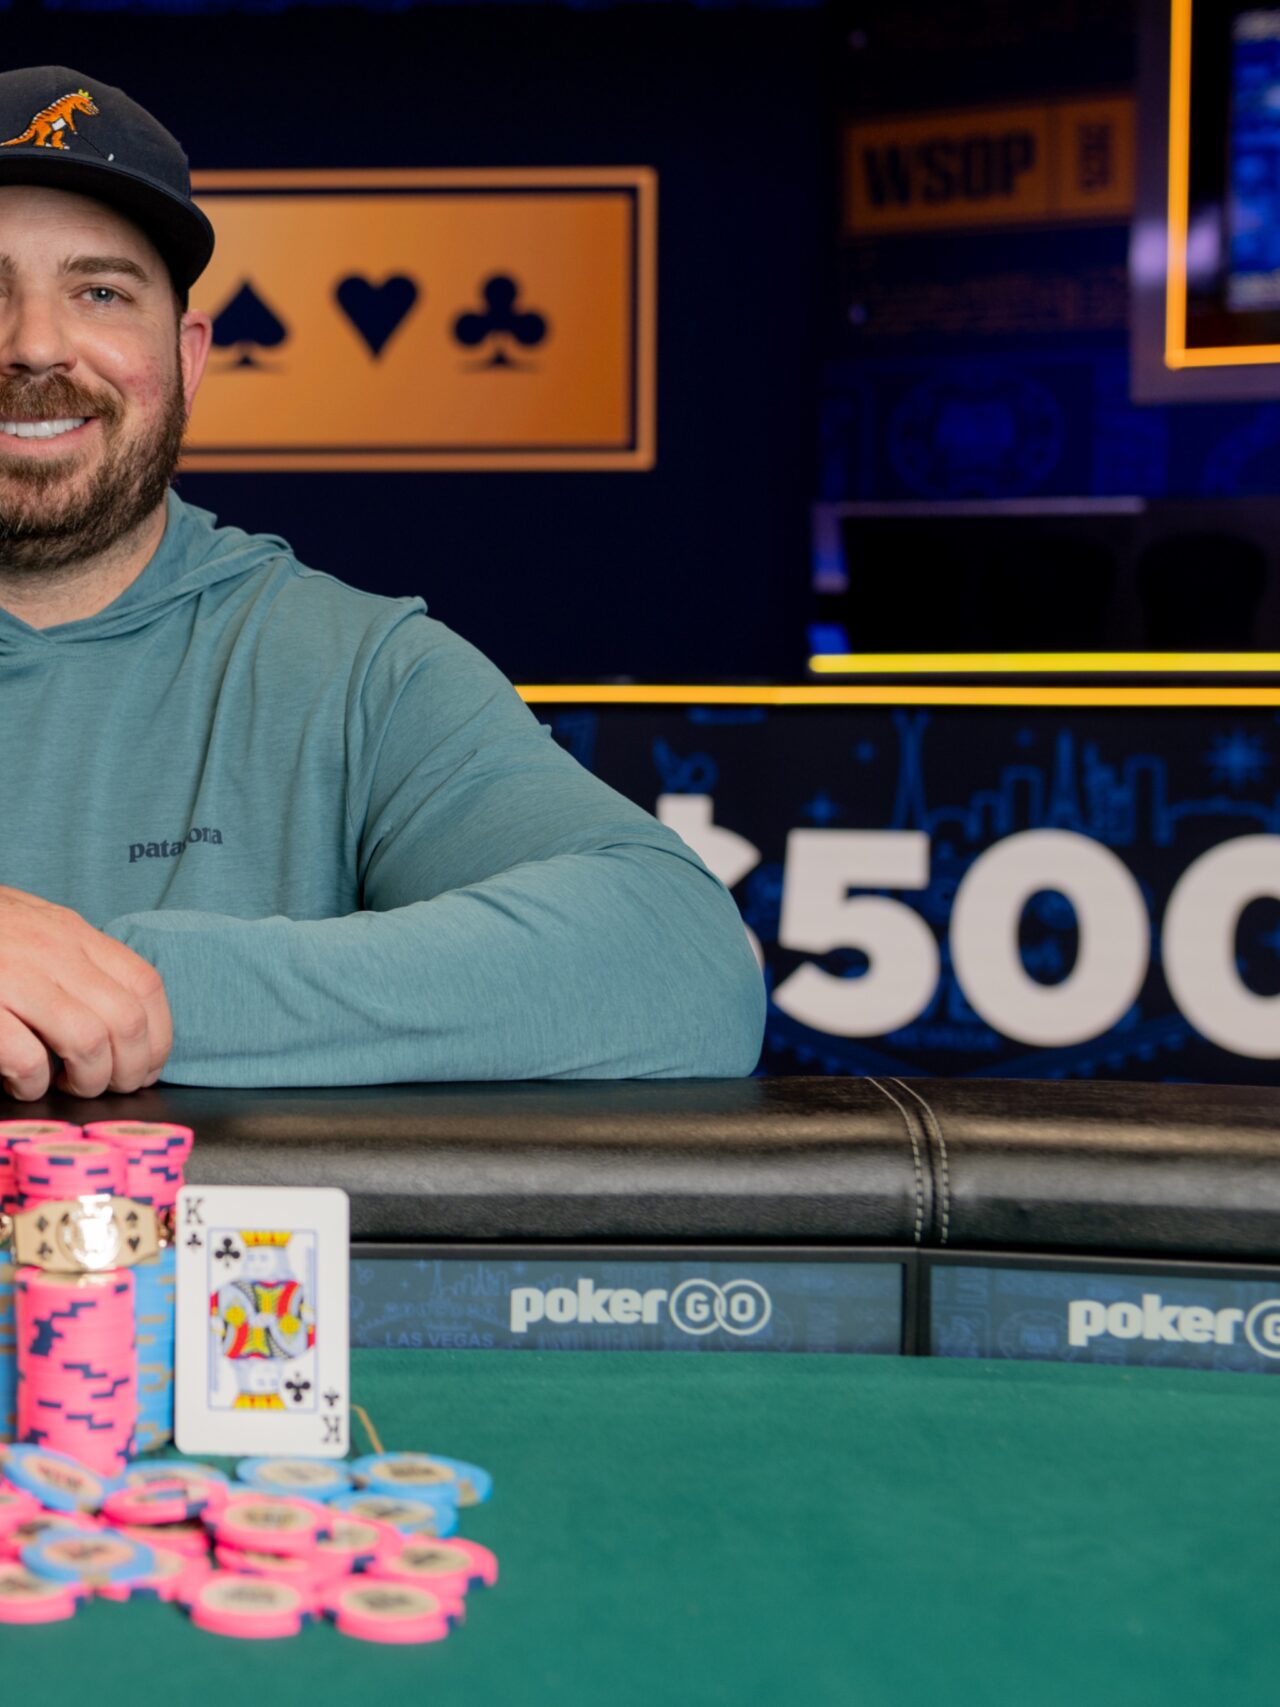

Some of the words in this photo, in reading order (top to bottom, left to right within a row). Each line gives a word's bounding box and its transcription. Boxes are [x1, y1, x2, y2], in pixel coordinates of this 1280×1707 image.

[863, 129, 1036, 207] WSOP
[656, 794, 1280, 1059] 500
[185, 1197, 204, 1225] K
[510, 1278, 772, 1335] pokerGO
[385, 1332, 422, 1347] LAS
[428, 1332, 494, 1347] VEGAS
[322, 1416, 342, 1444] K
